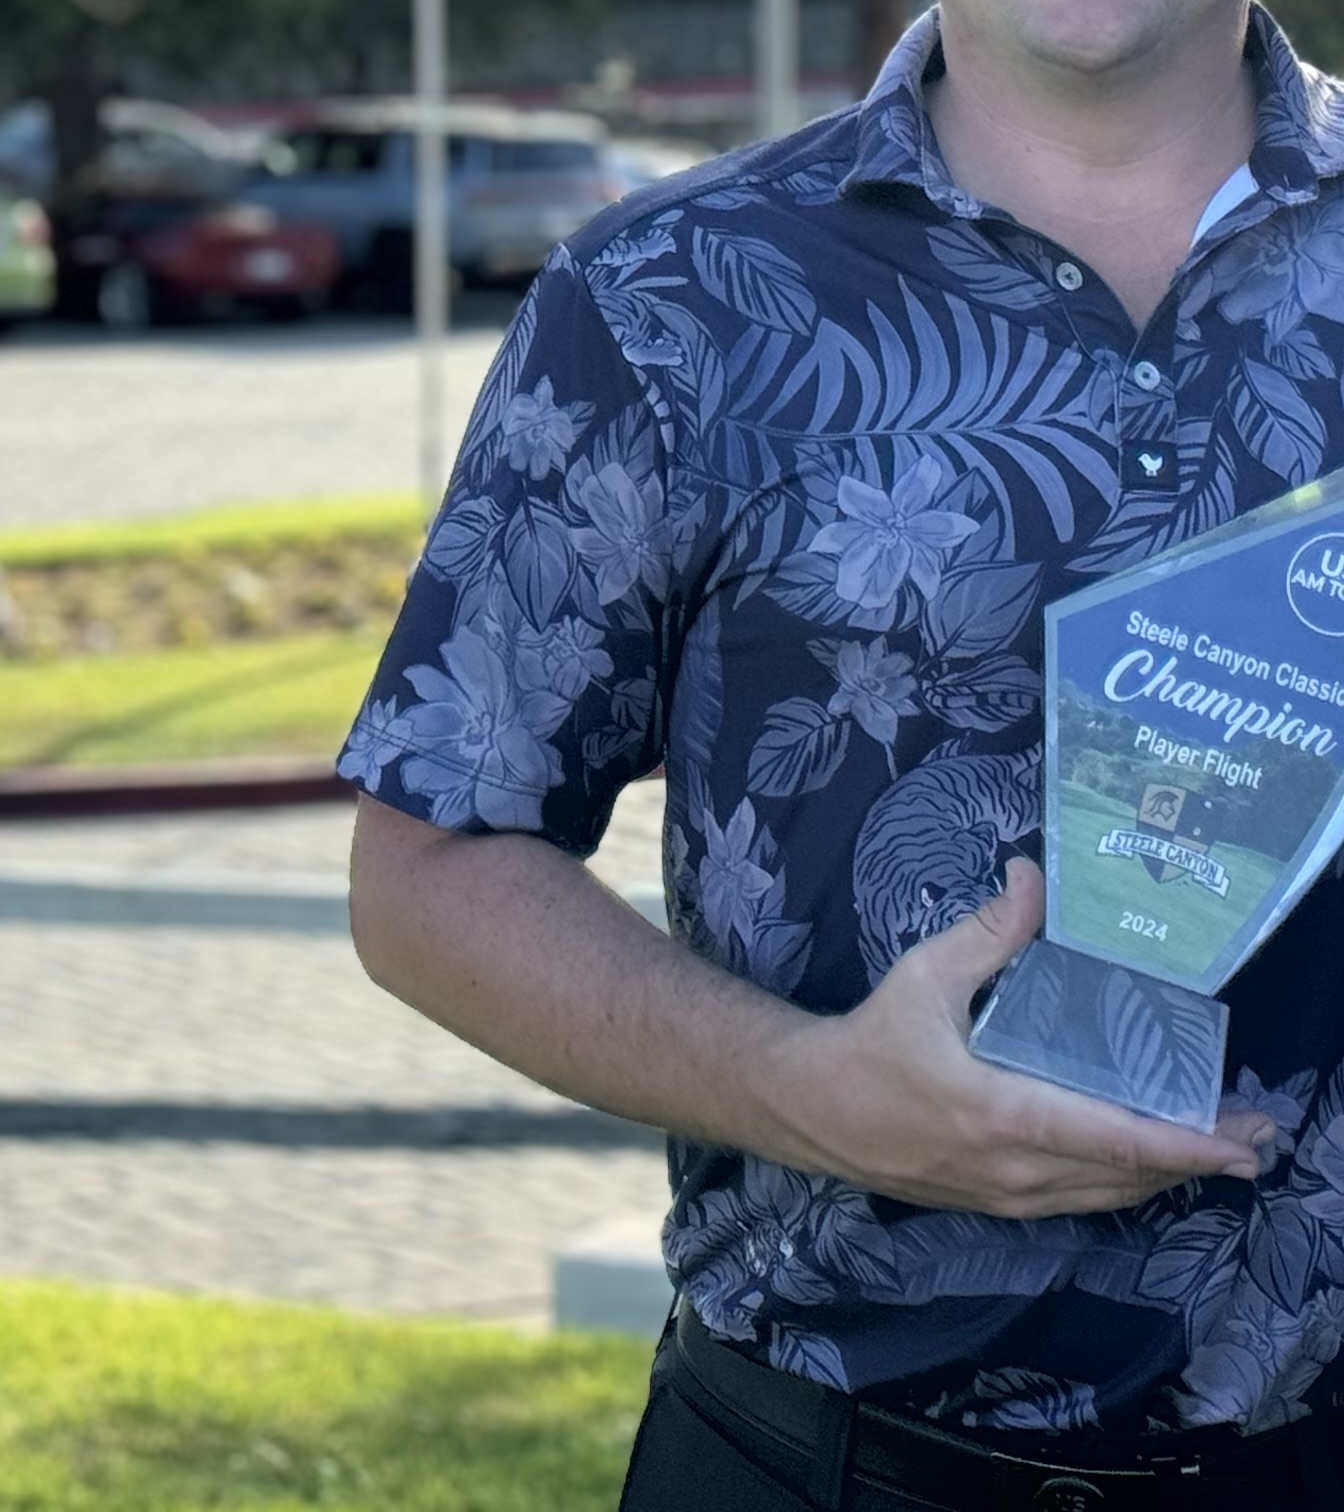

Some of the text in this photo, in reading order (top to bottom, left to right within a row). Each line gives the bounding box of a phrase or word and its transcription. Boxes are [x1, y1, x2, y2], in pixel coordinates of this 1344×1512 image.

[1291, 568, 1325, 594] AM
[1126, 610, 1189, 652] Steele
[1193, 635, 1271, 681] Canyon
[1104, 649, 1337, 757] Champion
[1134, 725, 1263, 789] Player Flight
[1114, 831, 1220, 882] STEELE CANYON
[1119, 911, 1169, 942] 2024
